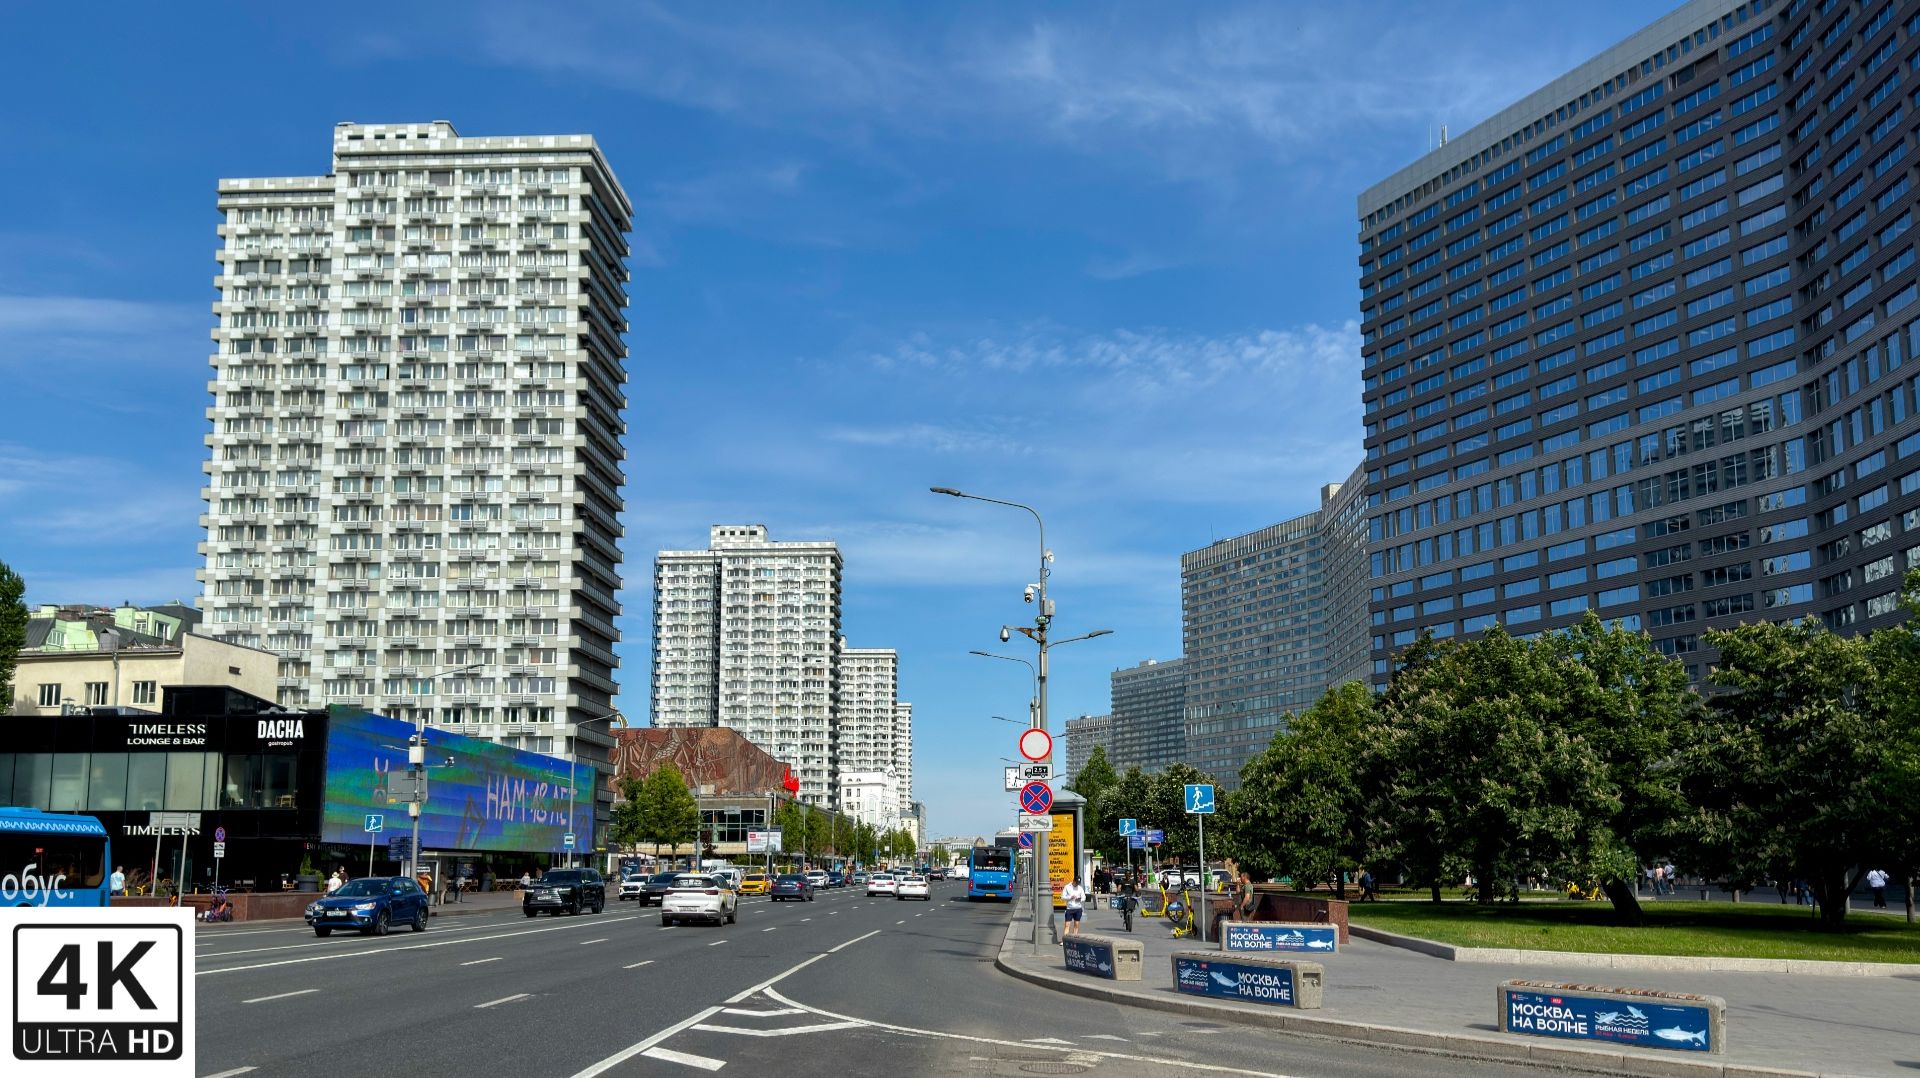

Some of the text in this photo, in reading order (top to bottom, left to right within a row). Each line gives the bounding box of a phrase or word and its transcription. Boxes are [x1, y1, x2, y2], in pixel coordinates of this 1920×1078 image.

[128, 724, 206, 735] TIMELESS
[257, 720, 304, 739] DACHA
[127, 737, 206, 745] LOUNGE & BAR
[486, 775, 527, 824] НАМ
[122, 825, 201, 836] TIMELESS
[1, 862, 74, 907] обус.
[1230, 933, 1266, 941] МОСКВА
[1230, 940, 1273, 949] НА ВОЛНЕ
[1237, 972, 1280, 987] МОСКВА
[1238, 985, 1291, 1001] НА ВОЛНЕ
[1512, 1002, 1575, 1020] МОСКВА
[1512, 1015, 1588, 1034] НА ВОЛНЕ
[1595, 1024, 1649, 1035] РЫБНАЯ НЕДЕЛЯ
